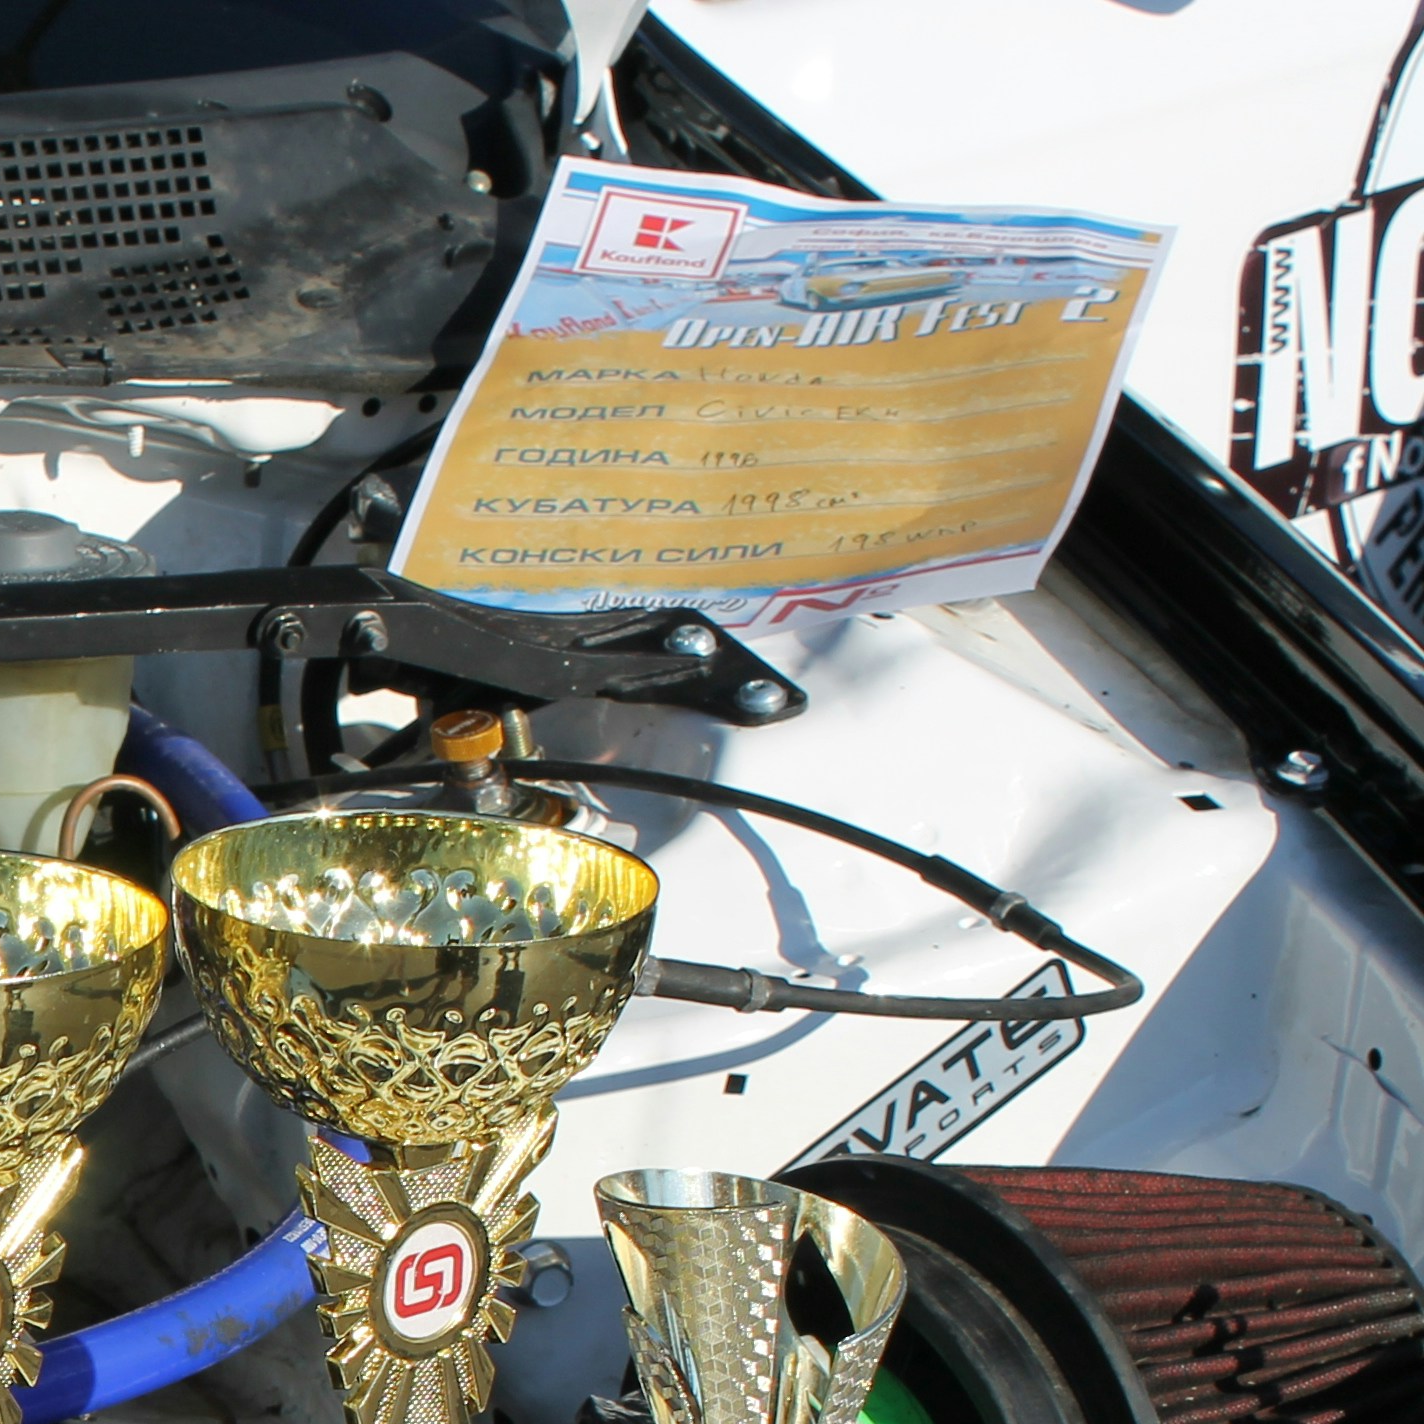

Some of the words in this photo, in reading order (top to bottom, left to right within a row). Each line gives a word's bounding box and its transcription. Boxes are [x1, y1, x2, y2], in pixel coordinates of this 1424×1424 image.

[599, 249, 707, 269] Kaufland
[1059, 285, 1119, 322] 2
[526, 368, 681, 384] МАРКА
[509, 403, 667, 421] МОДЕЛ
[492, 448, 671, 467] ГОДИНА
[472, 497, 702, 515] КУБАТУРА
[458, 546, 643, 565] КОНСКИ
[655, 542, 784, 564] СИЛИ
[820, 985, 1049, 1160] VATE
